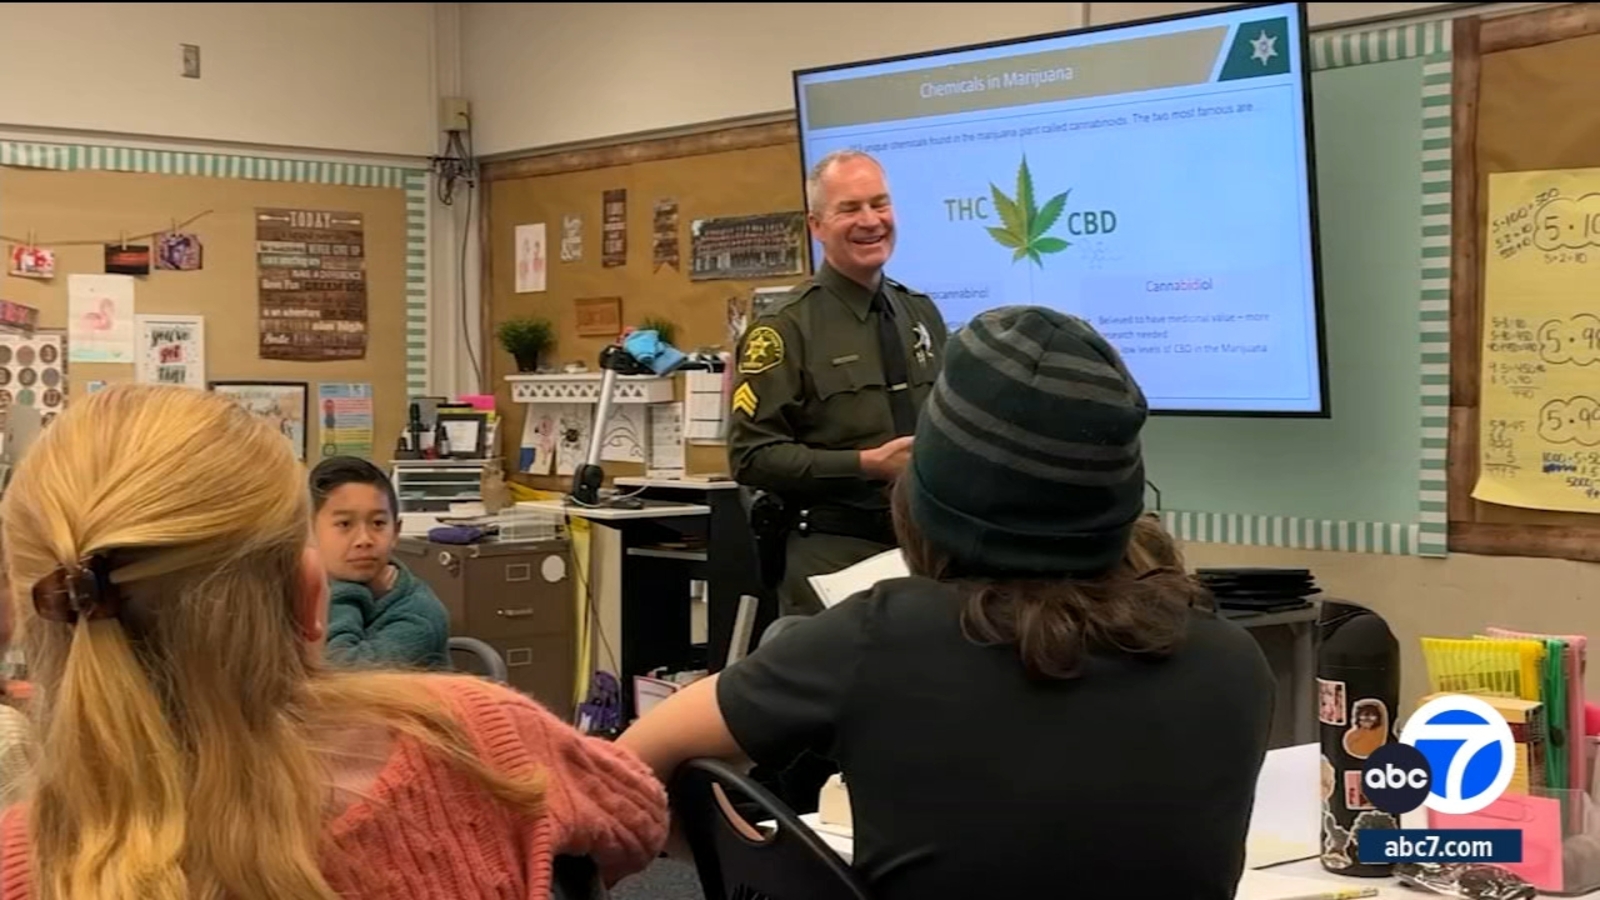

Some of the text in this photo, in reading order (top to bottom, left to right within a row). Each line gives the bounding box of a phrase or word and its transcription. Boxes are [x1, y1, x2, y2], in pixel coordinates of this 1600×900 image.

[919, 67, 1074, 99] Chemicals in Marijuana
[1042, 122, 1067, 133] called
[1132, 113, 1150, 123] The
[1152, 112, 1169, 121] two
[1171, 108, 1195, 119] most
[1197, 104, 1234, 117] famous
[289, 211, 331, 229] TODAY
[943, 196, 988, 222] THC
[1067, 210, 1118, 236] CBD
[1145, 278, 1214, 292] Cannabidiol
[1174, 343, 1193, 354] CBD
[1203, 343, 1219, 353] the
[1220, 342, 1268, 355] Marijuana
